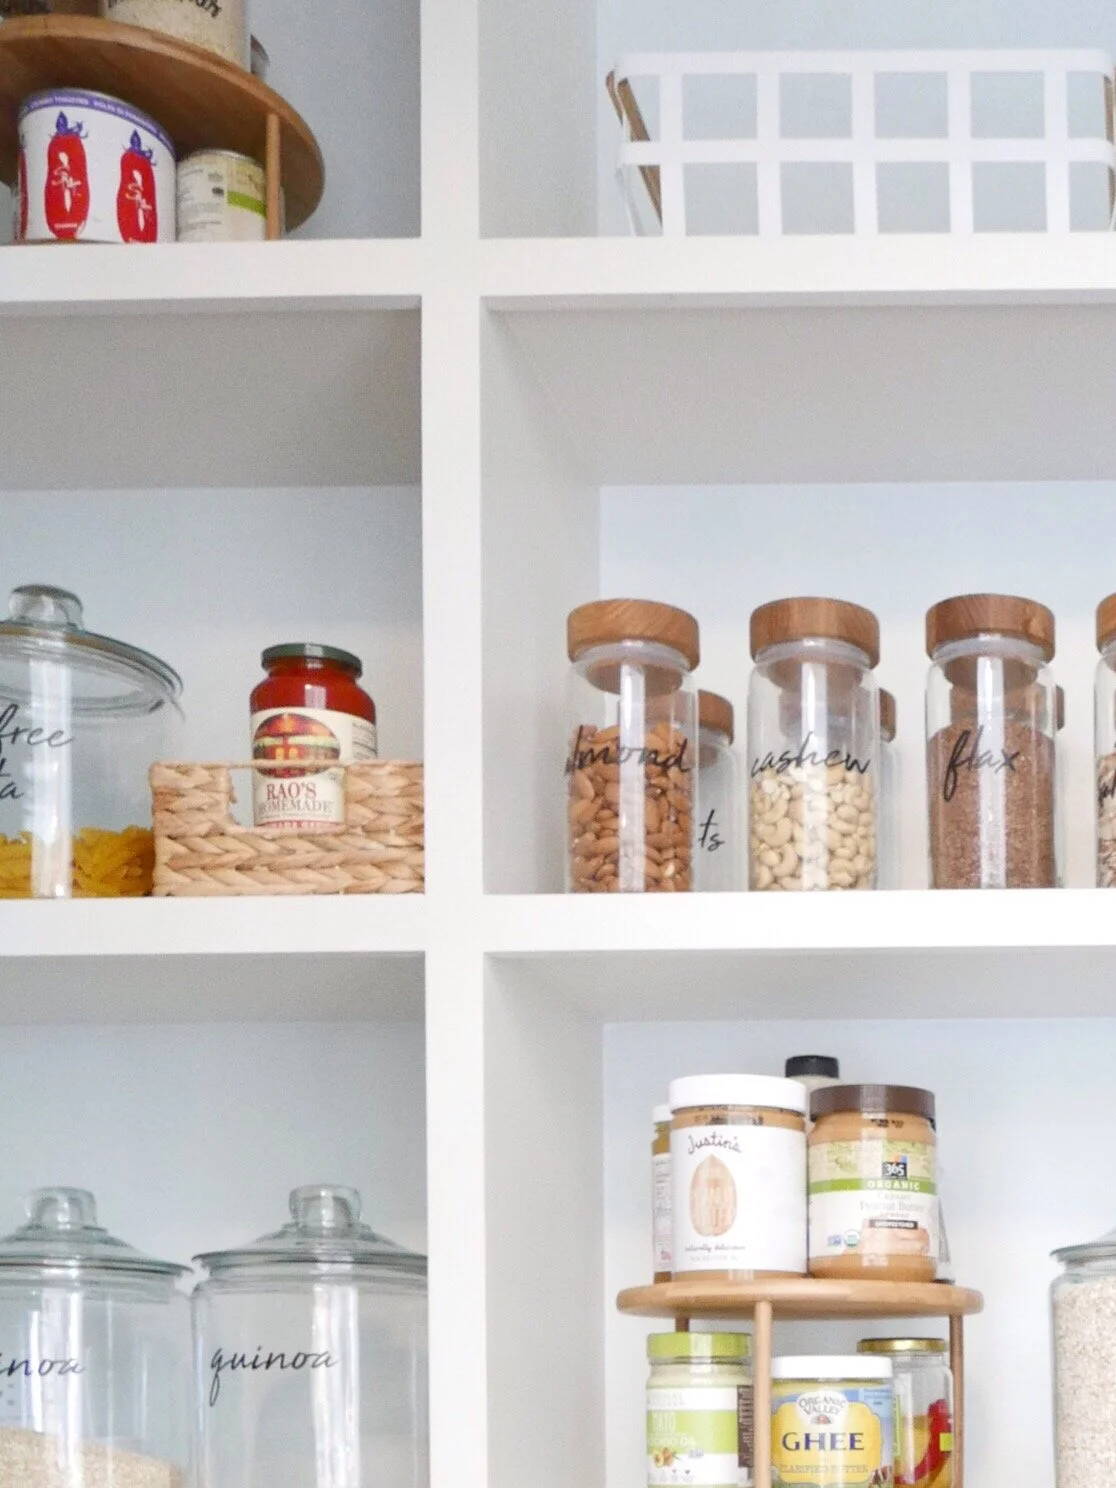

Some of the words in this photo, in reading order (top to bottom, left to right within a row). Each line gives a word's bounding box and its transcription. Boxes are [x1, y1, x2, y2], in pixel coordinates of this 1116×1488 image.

[943, 724, 1022, 802] flax
[266, 782, 318, 801] RAO'S
[687, 1131, 742, 1155] Justin's
[884, 1163, 906, 1177] 365
[867, 1180, 921, 1191] ORGANIC
[209, 1346, 340, 1408] quinoa
[798, 1395, 846, 1409] ORGANIC
[803, 1402, 842, 1416] VALLEY
[781, 1431, 865, 1452] GHEE
